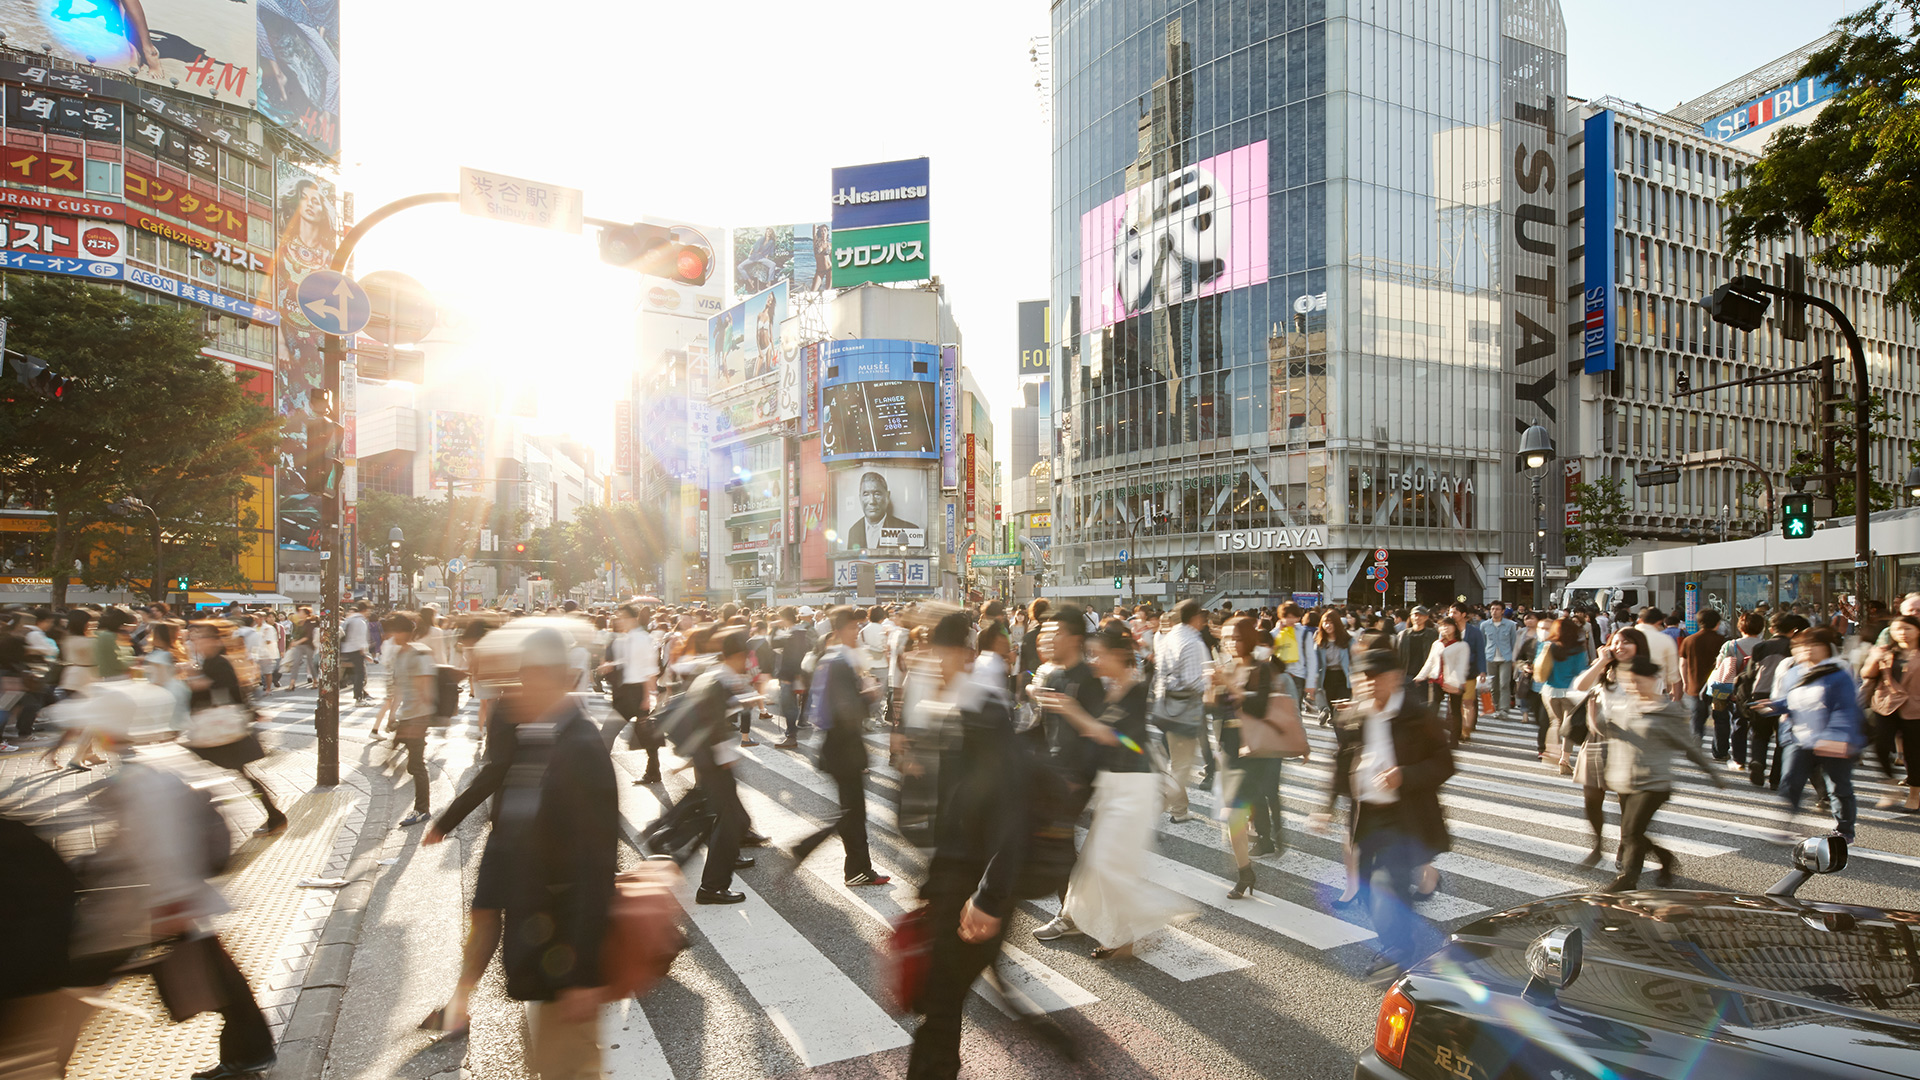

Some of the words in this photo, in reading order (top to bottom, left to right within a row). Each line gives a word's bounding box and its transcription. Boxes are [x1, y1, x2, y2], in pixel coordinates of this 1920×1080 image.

[18, 67, 88, 90] 月の宴
[186, 54, 248, 97] H&M
[21, 90, 36, 98] 9F
[22, 97, 115, 130] 月の宴
[136, 113, 149, 123] 9F
[1718, 78, 1816, 141] SEIBU
[300, 106, 335, 150] H&M
[137, 124, 212, 168] 月の宴
[10, 154, 78, 182] イス
[58, 200, 113, 216] GUSTO
[126, 171, 243, 231] コンタクト
[832, 186, 927, 205] Hisamitsu
[488, 202, 535, 221] Shibuya
[87, 239, 116, 249] ガスト
[212, 241, 264, 271] ガスト
[834, 240, 924, 268] サロンパス
[94, 265, 112, 275] 6F
[1515, 95, 1556, 450] TSUTAY
[132, 269, 174, 292] AEON
[181, 284, 277, 321] 英会話イーオン
[698, 300, 722, 311] VISA
[1586, 286, 1604, 358] SEIBU
[874, 395, 905, 404] FLANGER
[1388, 472, 1475, 495] TSUTAYA
[1218, 528, 1323, 551] TSUTAYA
[1505, 567, 1535, 577] TSUTAY
[1434, 1045, 1474, 1080] 足立
